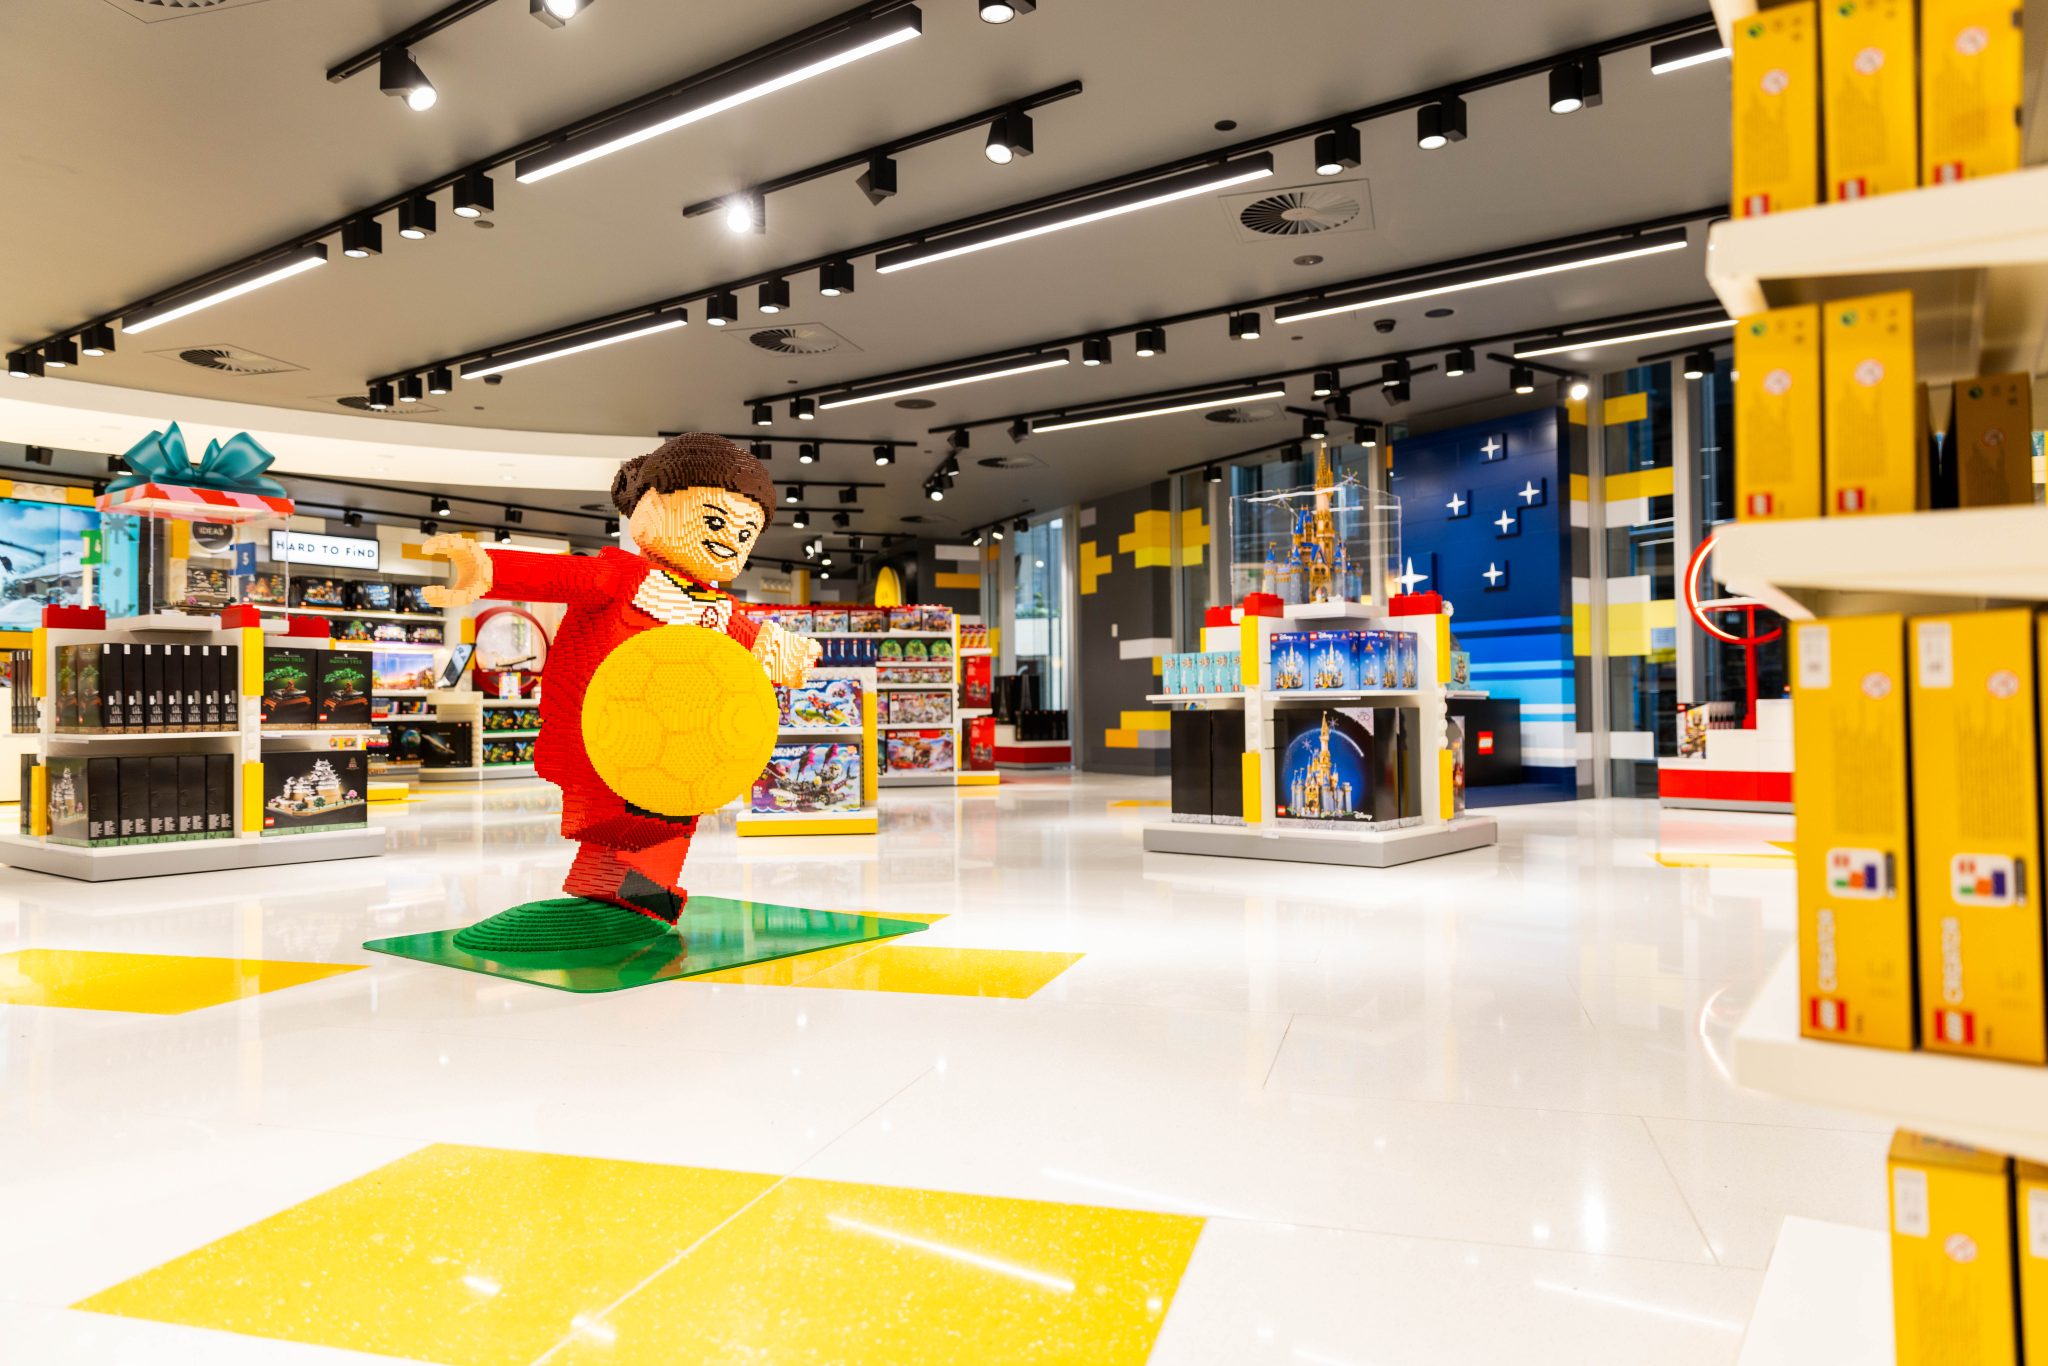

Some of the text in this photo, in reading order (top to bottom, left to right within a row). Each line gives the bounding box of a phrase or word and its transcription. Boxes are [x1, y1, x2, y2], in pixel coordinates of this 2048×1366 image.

[199, 527, 225, 536] IDEAS
[276, 540, 315, 552] HARD
[322, 545, 339, 555] TO
[242, 551, 250, 566] 5
